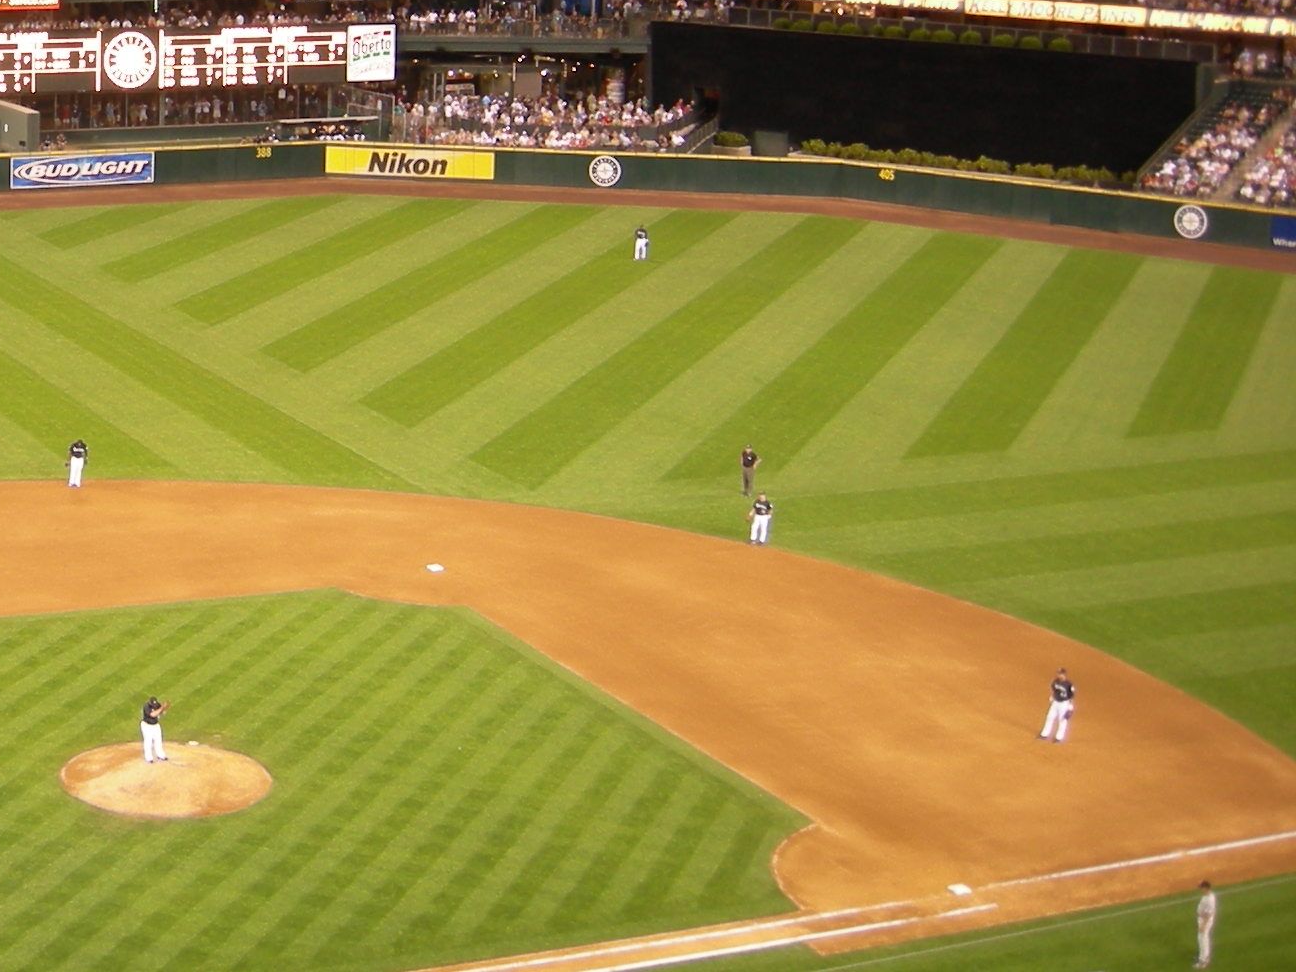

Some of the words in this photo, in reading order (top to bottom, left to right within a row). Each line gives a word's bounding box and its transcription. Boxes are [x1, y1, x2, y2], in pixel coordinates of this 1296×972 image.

[353, 38, 392, 57] Oberto
[29, 163, 80, 179] BUD
[82, 160, 149, 177] LIGHT
[368, 151, 448, 176] Nikon
